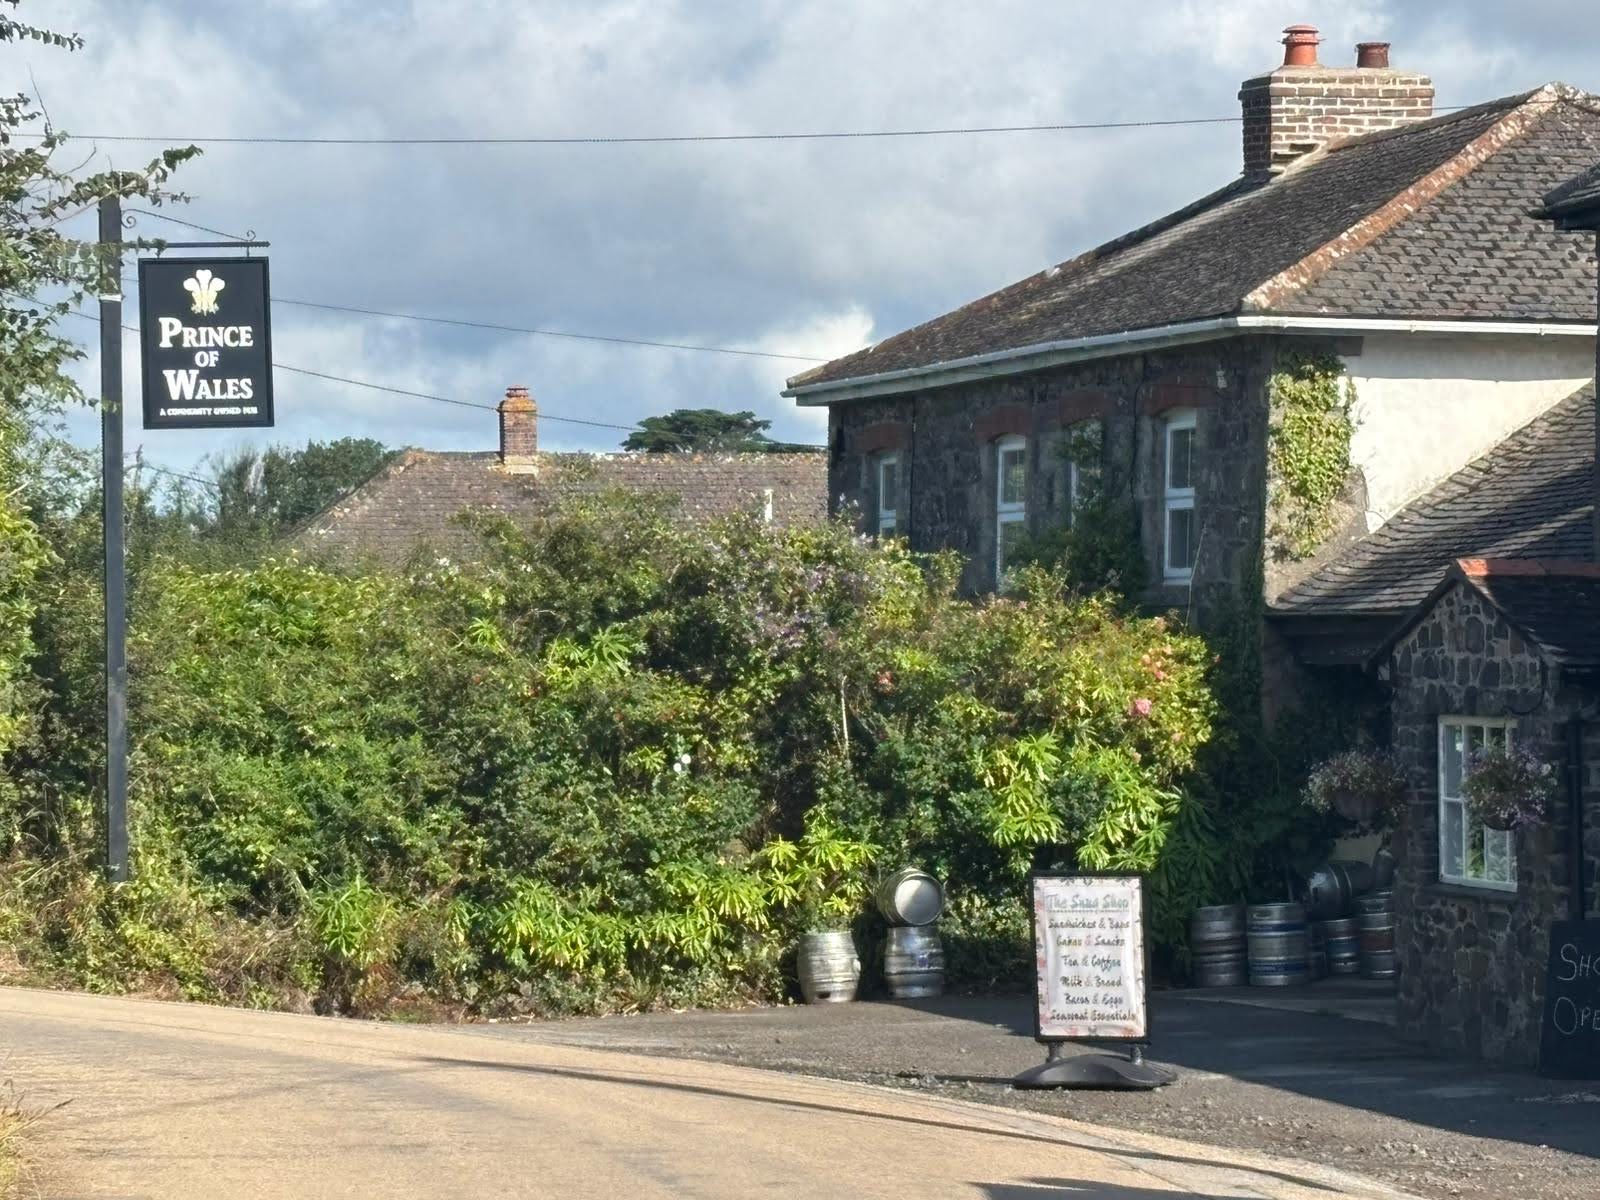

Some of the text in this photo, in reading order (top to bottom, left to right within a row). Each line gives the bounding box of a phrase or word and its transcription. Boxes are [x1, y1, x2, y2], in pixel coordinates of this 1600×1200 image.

[158, 317, 254, 348] PRINCE
[194, 350, 220, 367] OF
[162, 369, 254, 400] WALES
[159, 408, 167, 417] A
[1046, 894, 1068, 909] The
[1098, 917, 1106, 929] &
